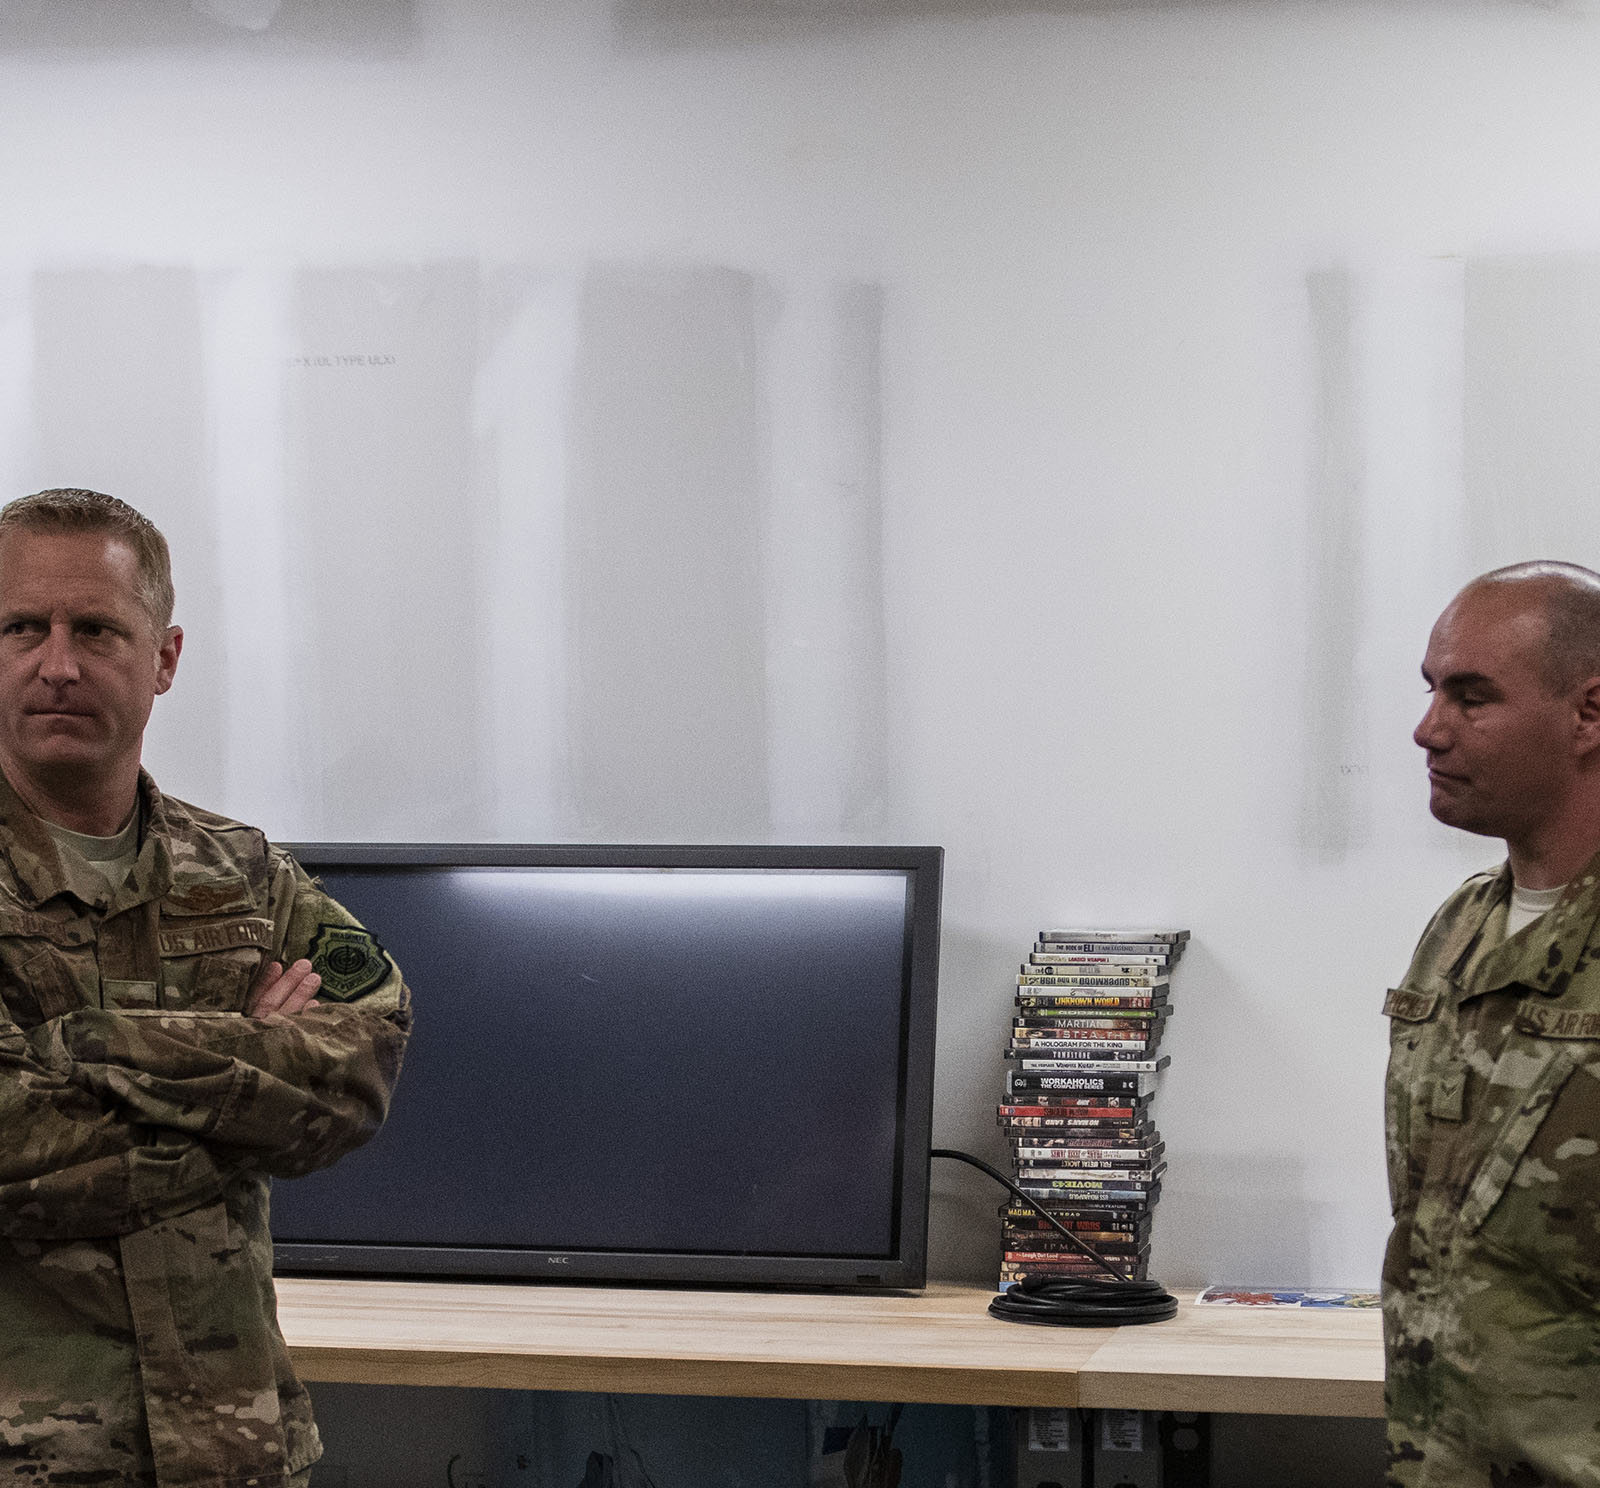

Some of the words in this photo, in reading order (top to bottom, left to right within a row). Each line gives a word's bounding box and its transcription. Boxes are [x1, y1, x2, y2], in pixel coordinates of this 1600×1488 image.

[193, 926, 223, 949] AIR
[1040, 977, 1056, 986] USA
[1054, 997, 1093, 1006] UNKNOWN
[1094, 997, 1120, 1006] WORLD
[1057, 1019, 1104, 1028] MARTIAN
[1551, 1012, 1579, 1036] AIR
[1063, 1030, 1123, 1040] STEALTH
[1053, 1051, 1091, 1060] TOMBSTONE
[1060, 1160, 1081, 1168] JACKET
[1081, 1160, 1099, 1168] METAL
[1100, 1160, 1112, 1168] FULL
[1065, 1180, 1103, 1189] MOVIE
[1008, 1208, 1024, 1217] MAD
[1024, 1209, 1037, 1217] MAX
[1059, 1242, 1077, 1250] MA
